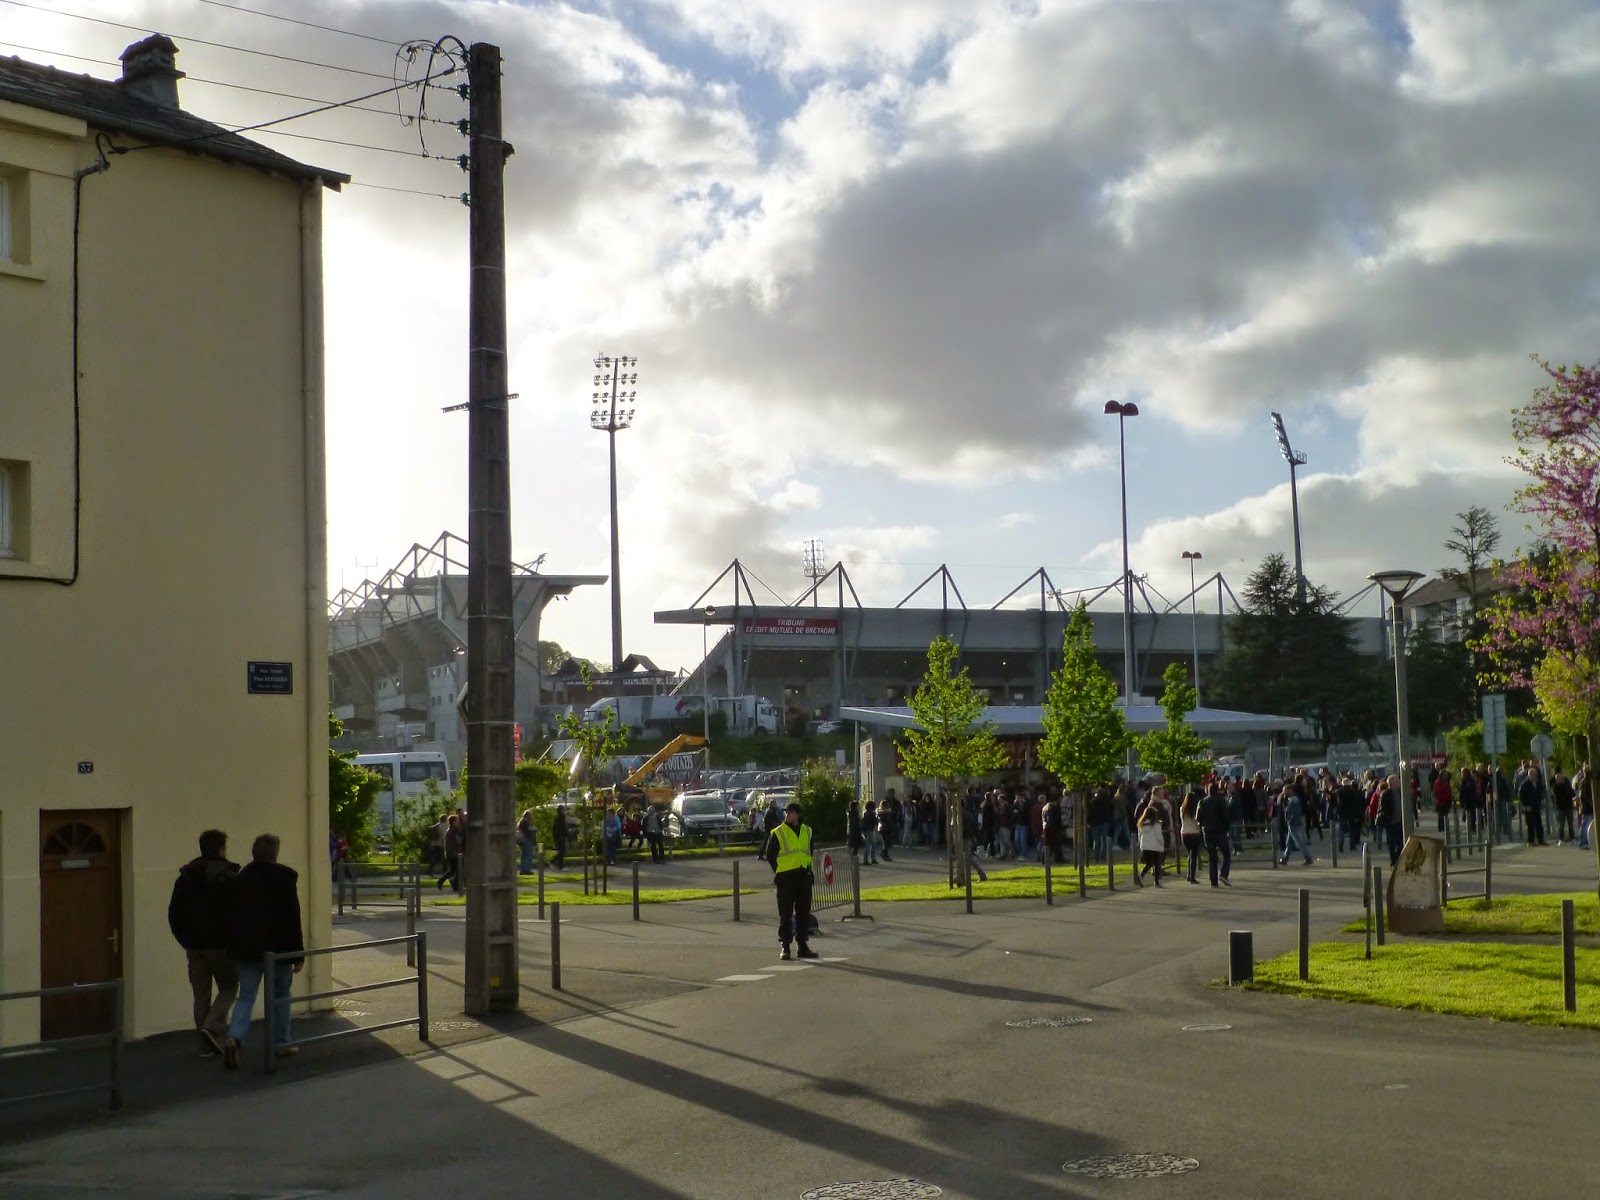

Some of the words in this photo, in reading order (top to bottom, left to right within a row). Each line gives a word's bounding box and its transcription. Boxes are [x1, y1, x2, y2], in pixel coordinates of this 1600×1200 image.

[769, 626, 794, 634] MUTUEL
[795, 626, 804, 634] DE
[81, 764, 91, 772] 37
